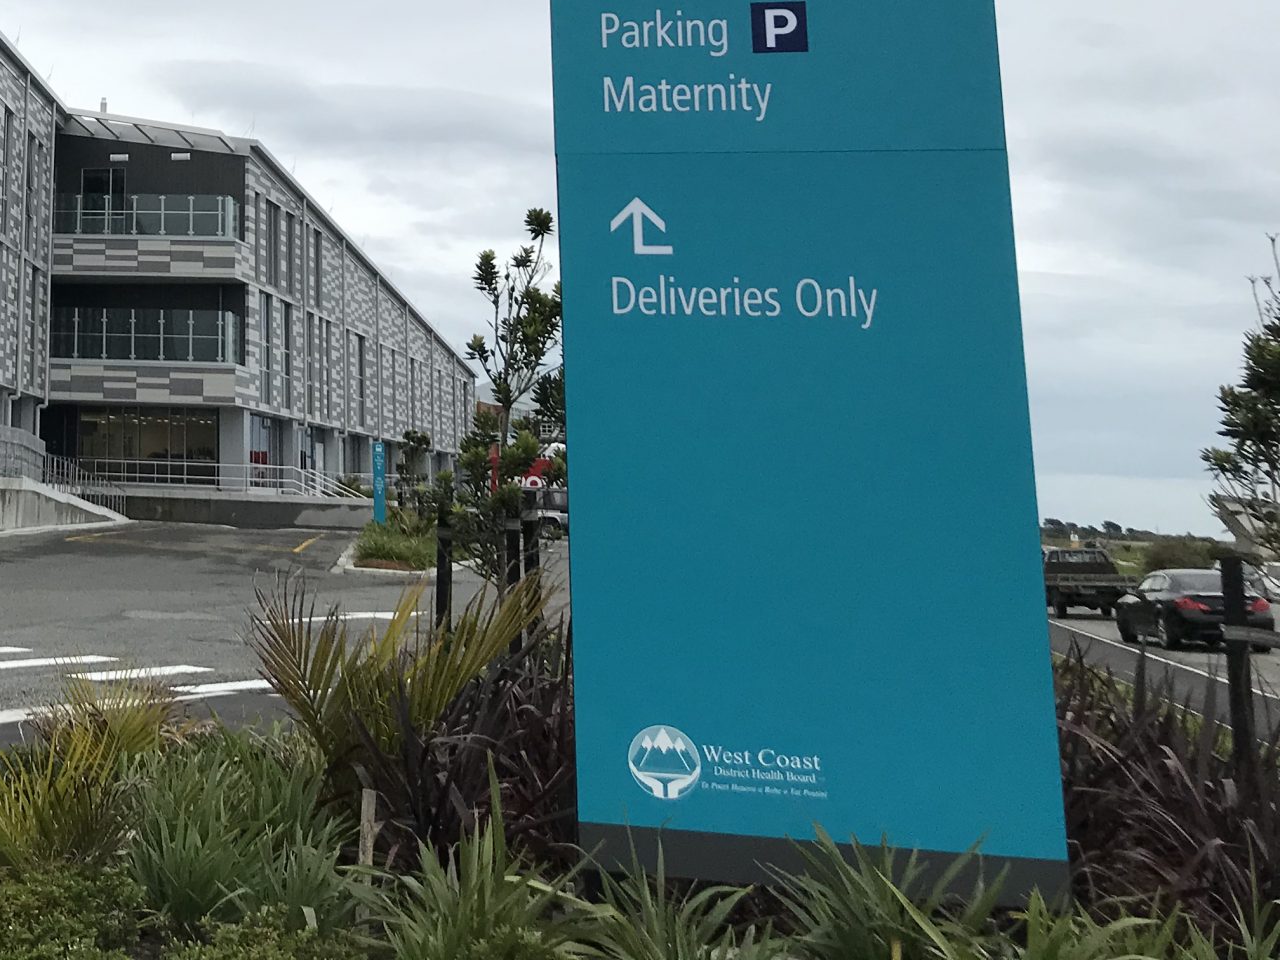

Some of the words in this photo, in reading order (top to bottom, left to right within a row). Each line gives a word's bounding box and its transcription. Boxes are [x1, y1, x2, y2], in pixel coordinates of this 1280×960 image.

[600, 9, 728, 57] Parking
[764, 8, 798, 48] P
[602, 73, 772, 122] Maternity
[611, 274, 781, 317] Deliveries
[795, 276, 877, 329] Only
[702, 744, 751, 766] West
[757, 748, 821, 771] Coast
[713, 765, 750, 778] District
[751, 768, 784, 781] Health
[786, 771, 816, 784] Board
